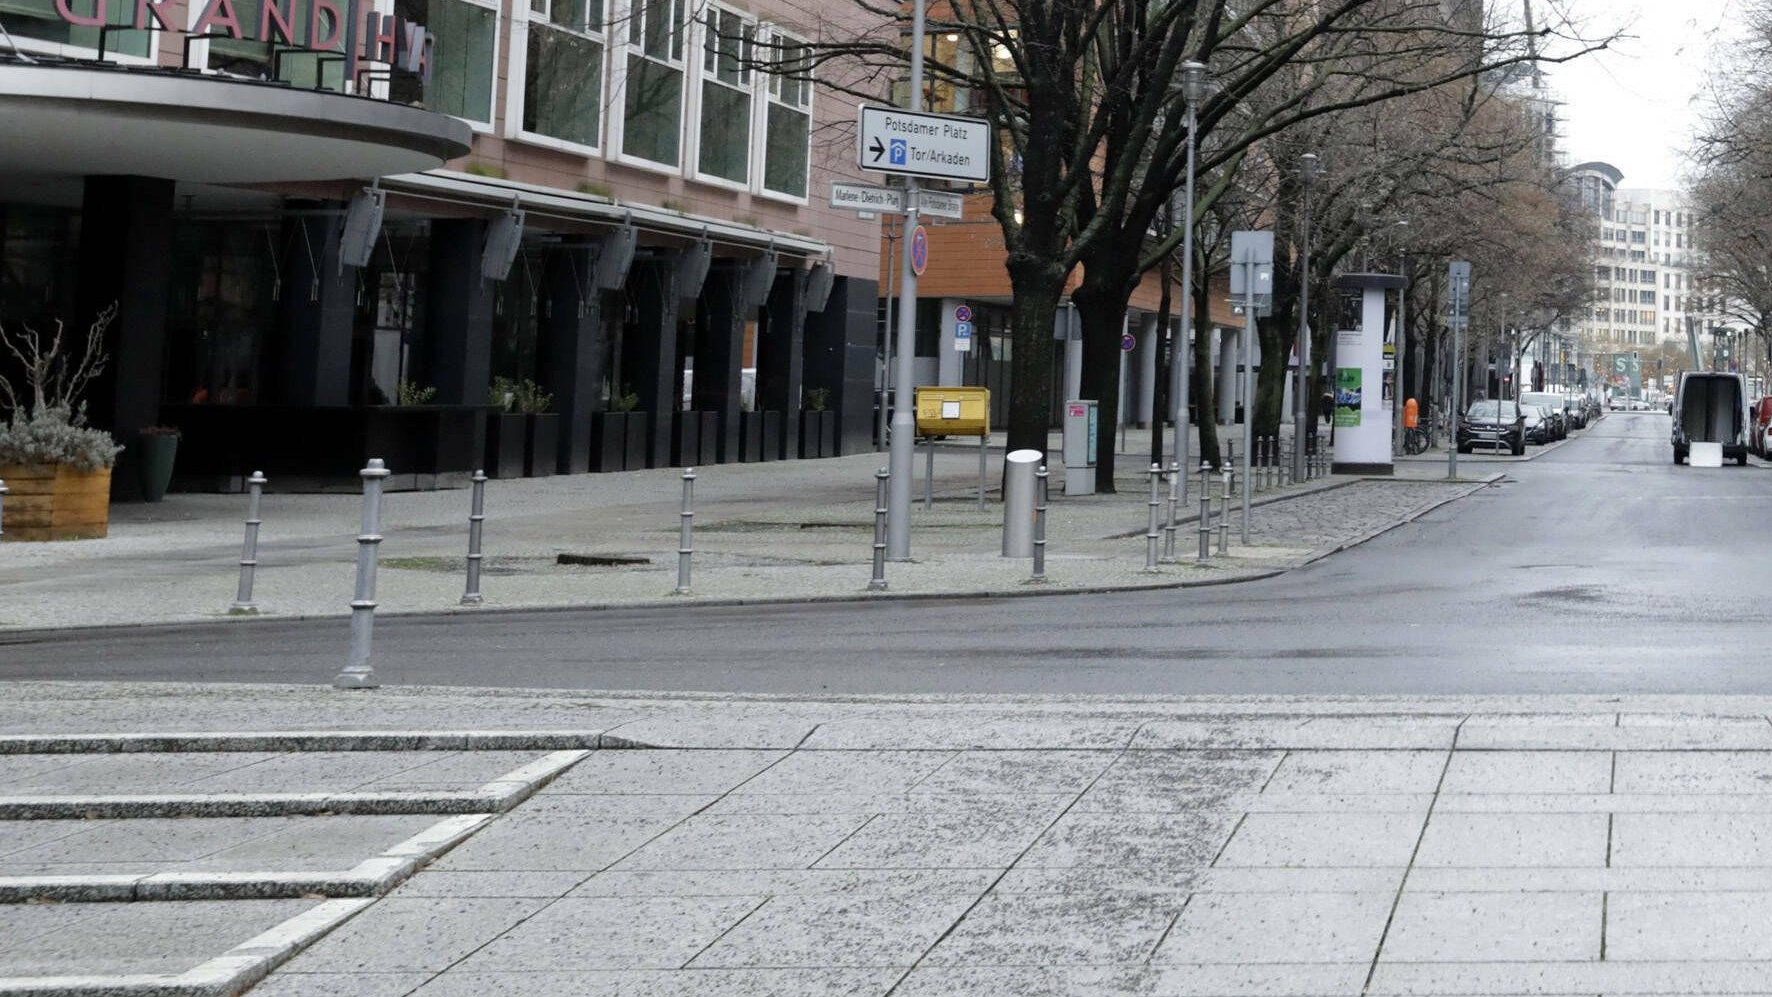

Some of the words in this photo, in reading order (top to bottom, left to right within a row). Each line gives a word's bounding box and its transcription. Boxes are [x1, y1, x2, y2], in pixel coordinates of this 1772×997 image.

[885, 116, 940, 138] Potsdamer
[943, 124, 968, 140] Platz
[910, 146, 970, 167] Tor/Arkaden
[1615, 357, 1626, 372] S
